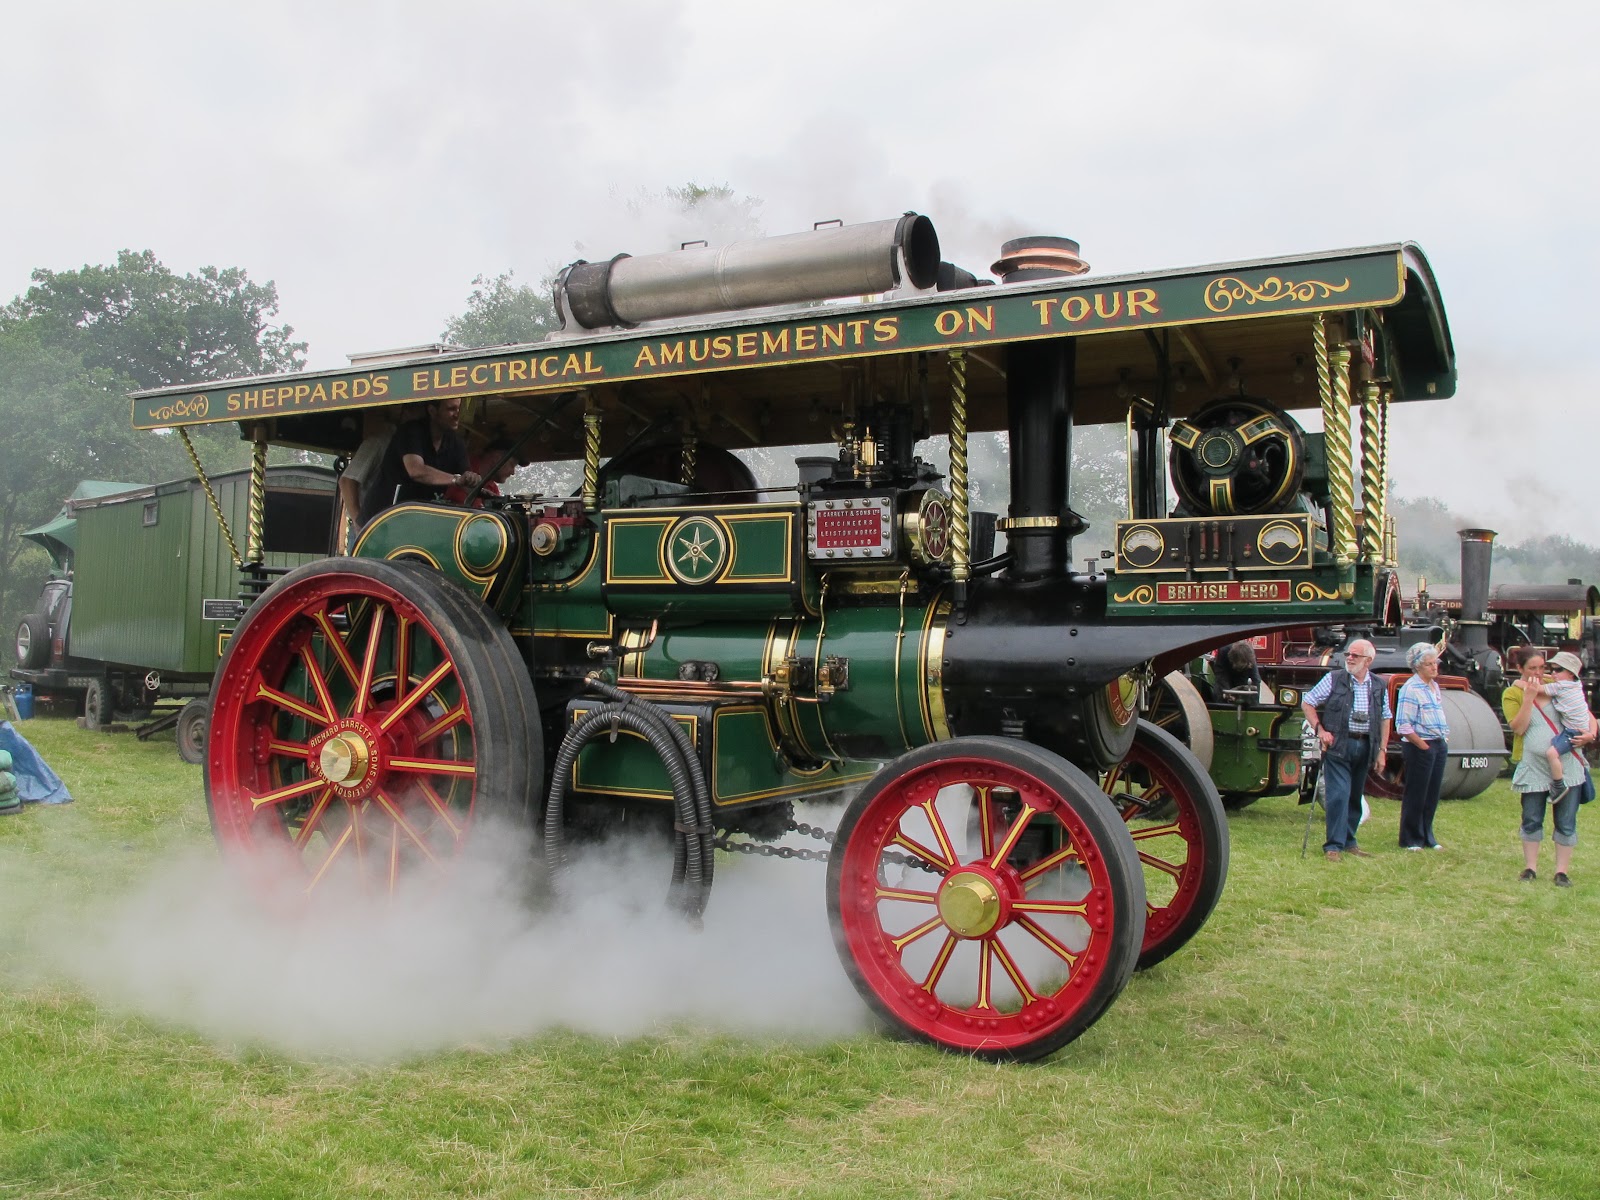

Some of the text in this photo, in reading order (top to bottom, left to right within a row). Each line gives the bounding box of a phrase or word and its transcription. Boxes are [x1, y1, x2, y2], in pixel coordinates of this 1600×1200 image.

[227, 288, 1159, 411] SHEPPARD'S ELECTRICAL AMUSEMENTS ON TOUR
[824, 520, 873, 528] ENGINEERS
[1168, 583, 1278, 600] BRITISH HERO
[310, 724, 339, 748] RICHARD
[340, 720, 372, 739] GARRETT
[370, 749, 378, 777] SONS
[333, 784, 365, 798] LEISTON
